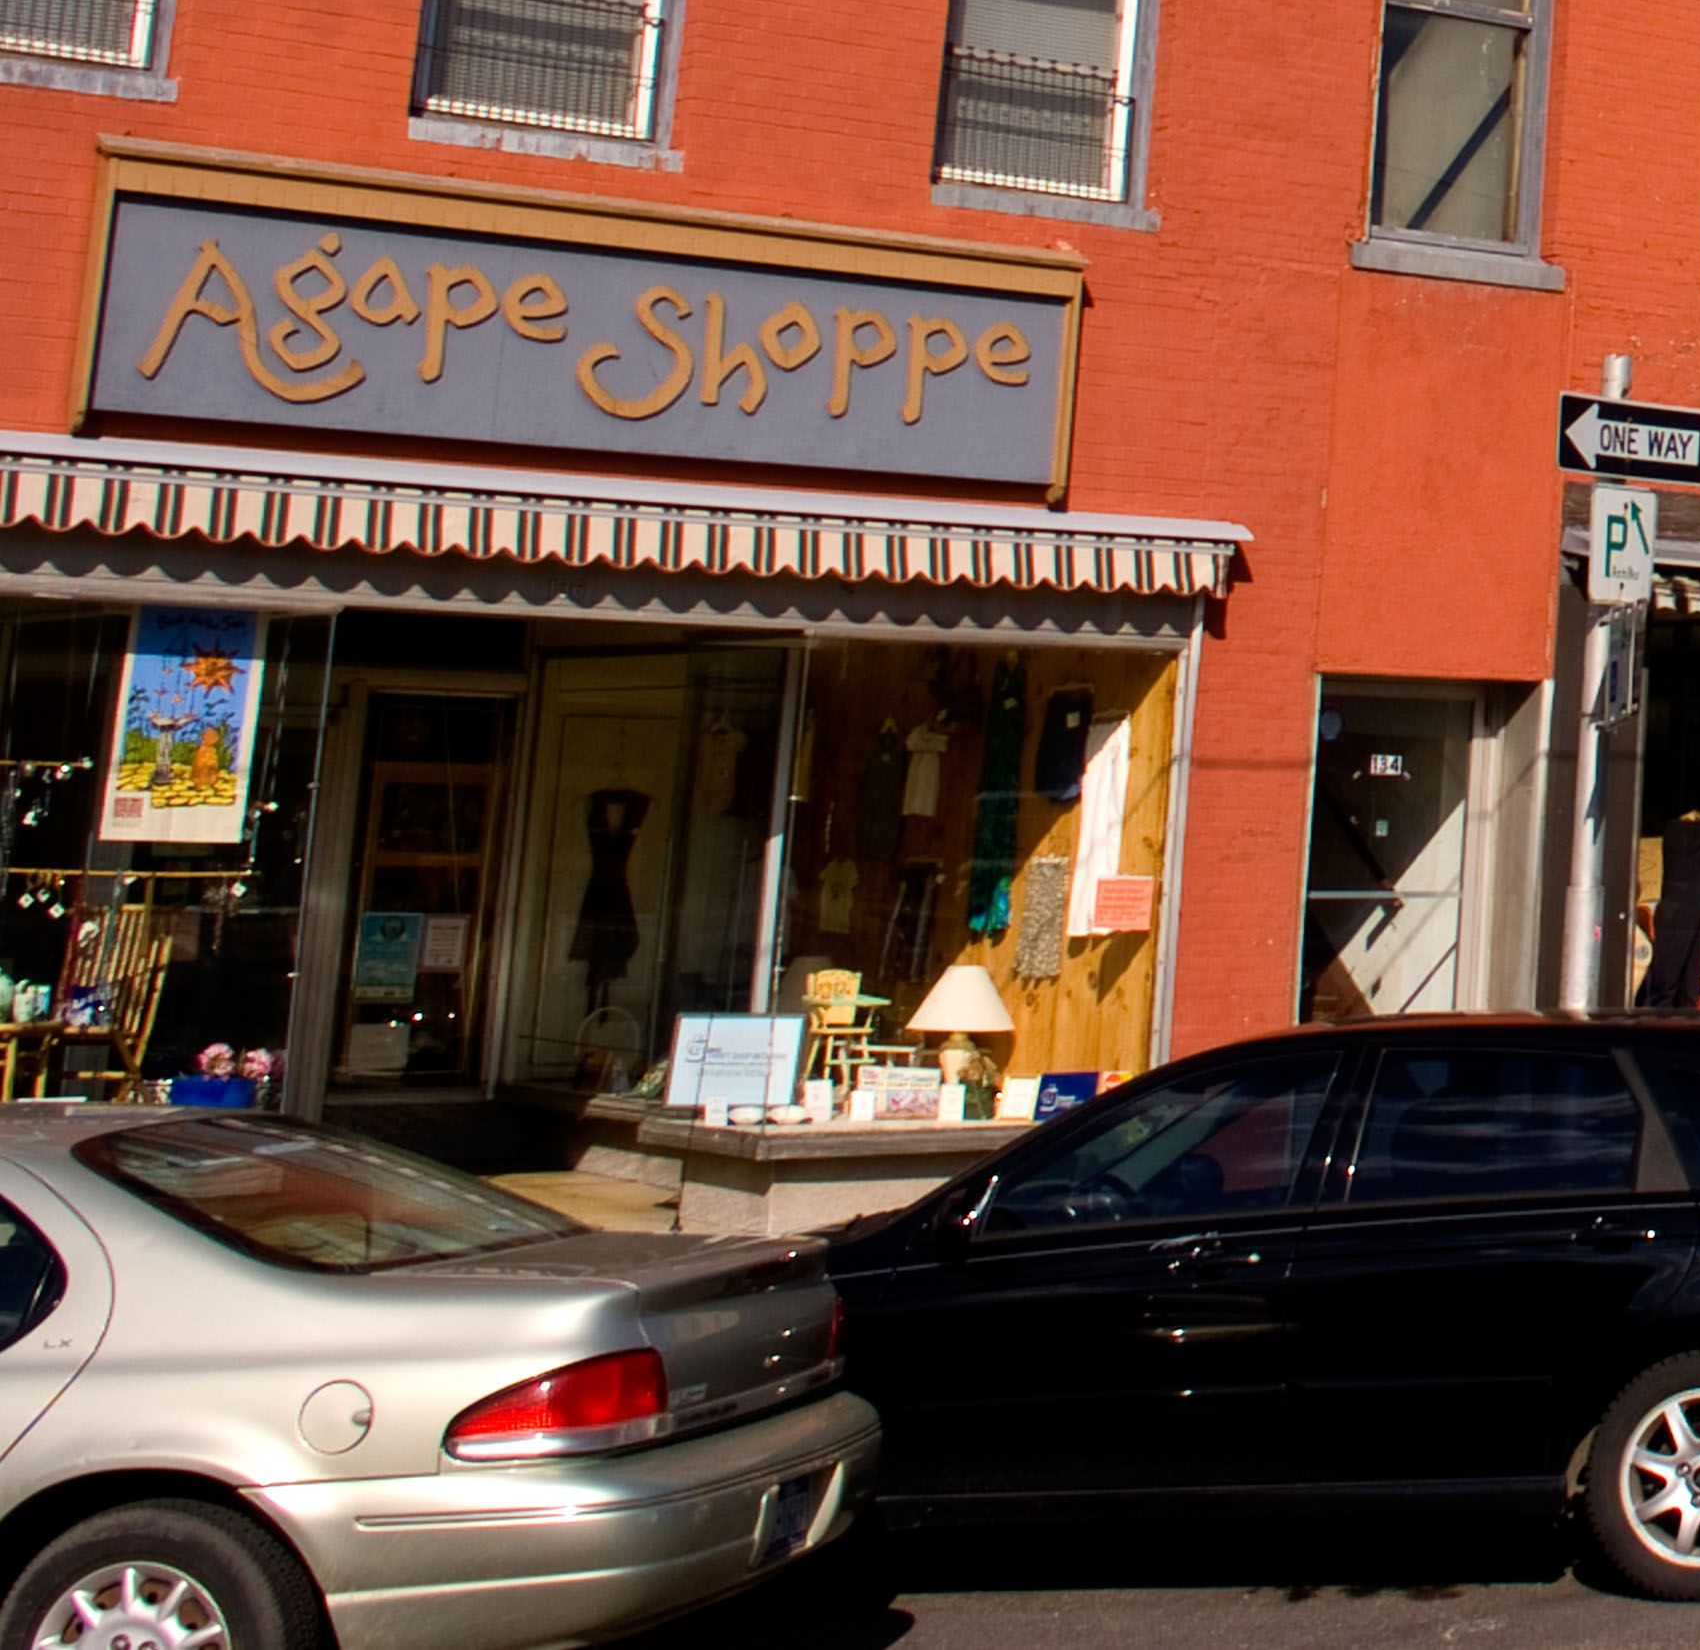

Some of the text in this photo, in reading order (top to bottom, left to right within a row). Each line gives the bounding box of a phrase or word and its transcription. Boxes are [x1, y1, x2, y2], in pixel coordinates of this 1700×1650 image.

[138, 232, 1031, 425] Agape Shoppe
[1600, 423, 1693, 461] ONE WAY
[1604, 513, 1628, 578] P
